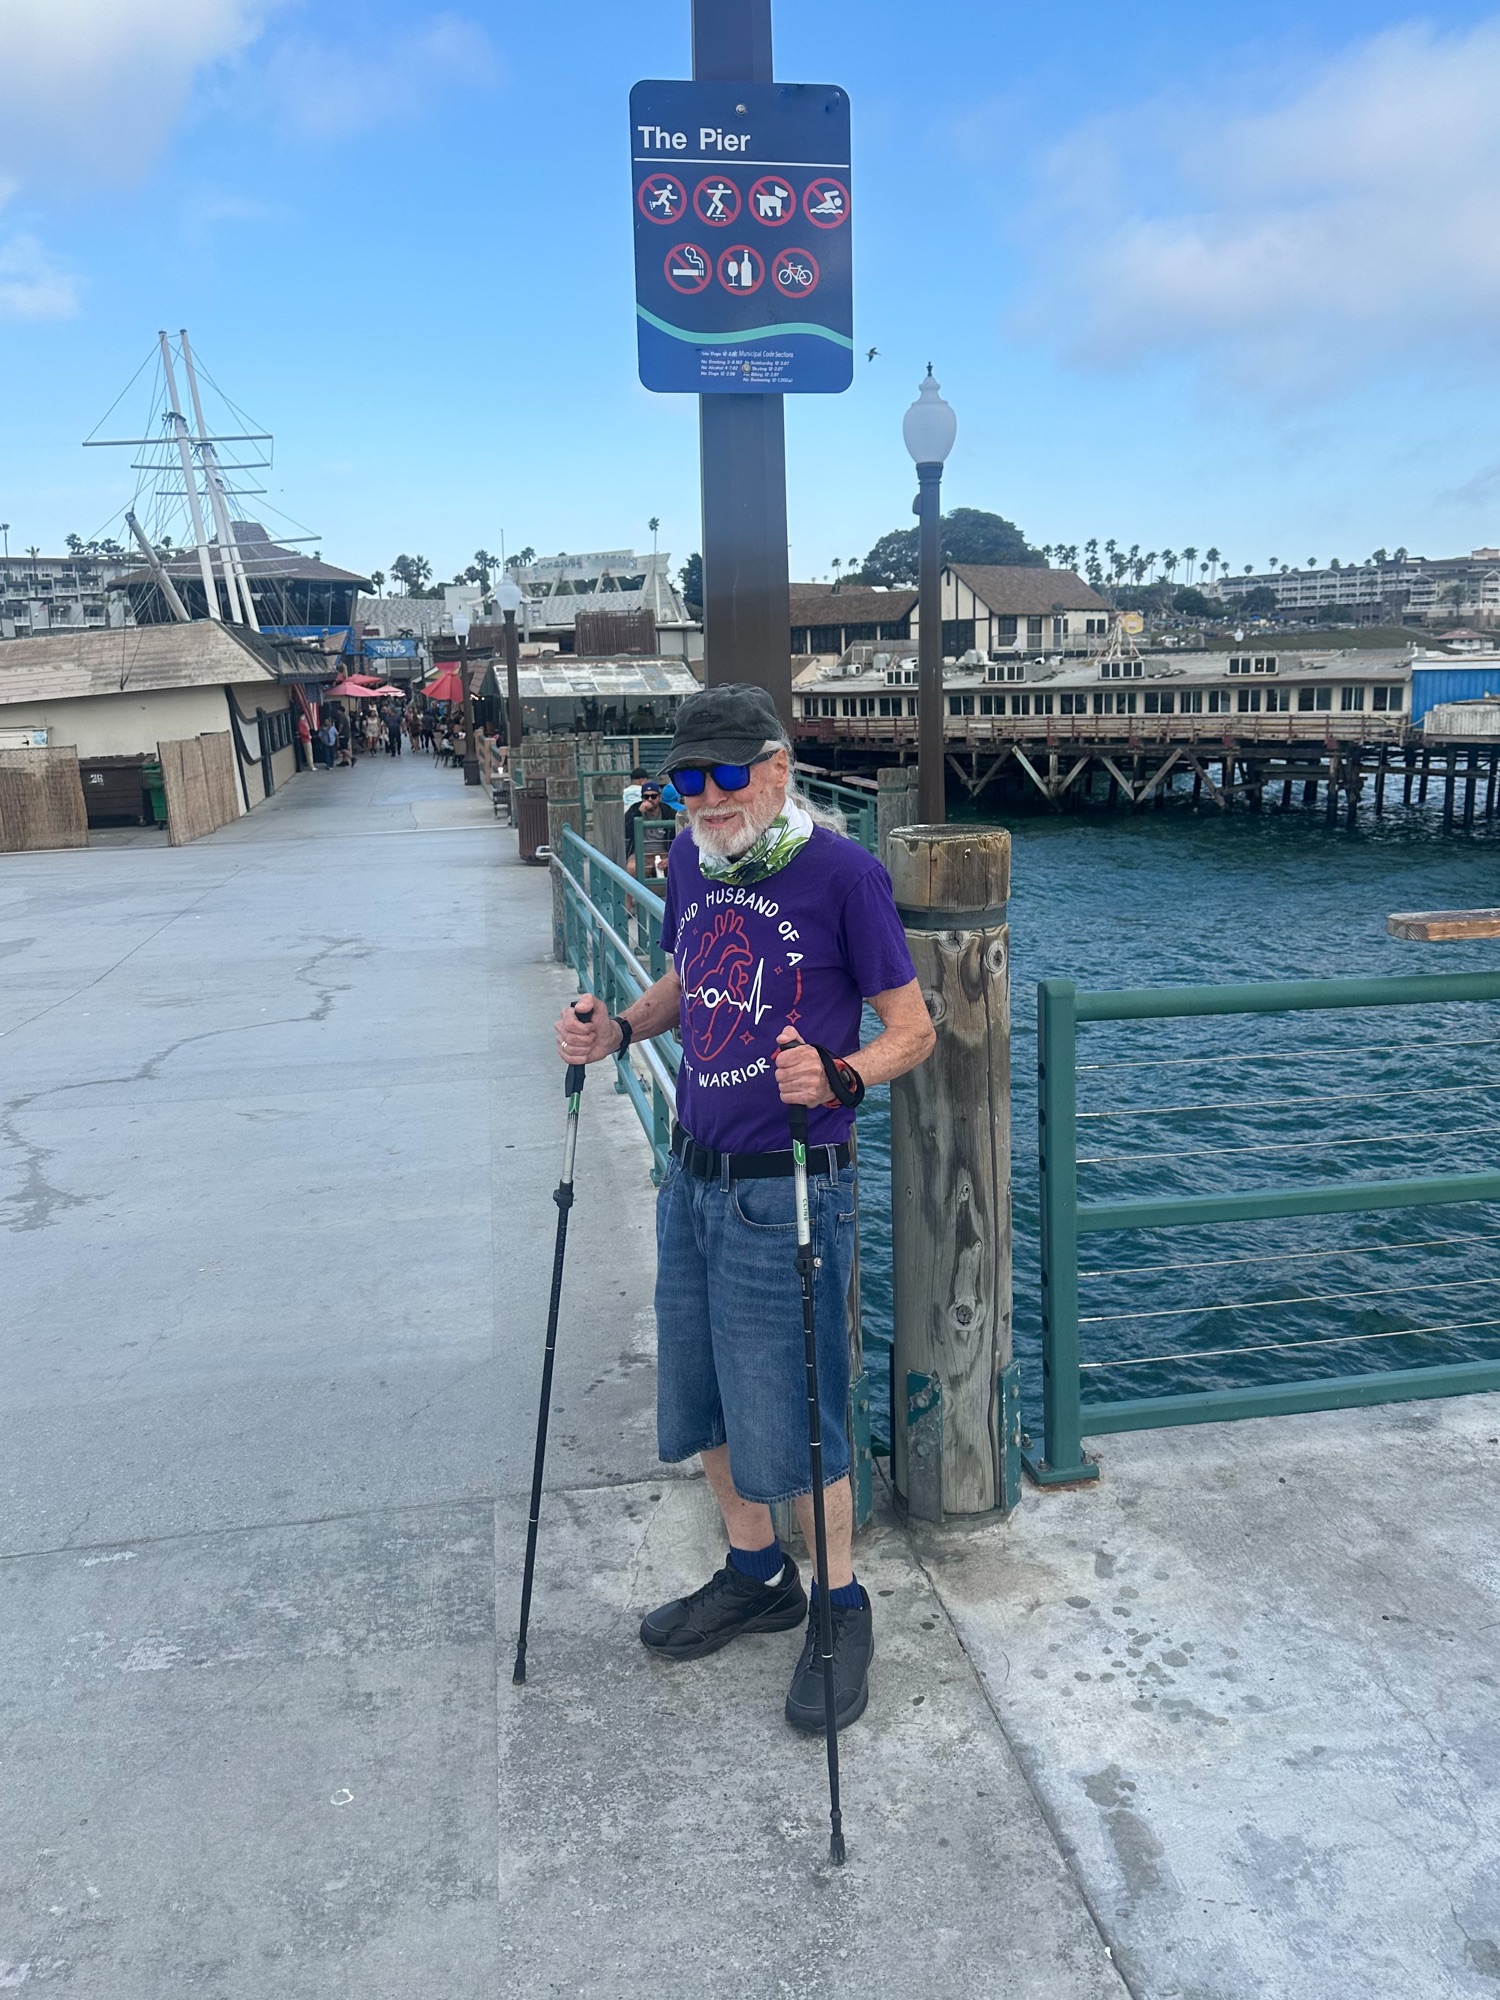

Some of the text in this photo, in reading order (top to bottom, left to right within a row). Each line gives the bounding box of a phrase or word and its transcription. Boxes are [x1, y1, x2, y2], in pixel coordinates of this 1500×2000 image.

[637, 126, 751, 152] The Pier
[375, 645, 407, 654] TONY'S
[706, 888, 779, 918] HUSBAND
[778, 920, 800, 942] OF
[786, 951, 804, 967] A
[698, 1057, 771, 1088] WARRIOR
